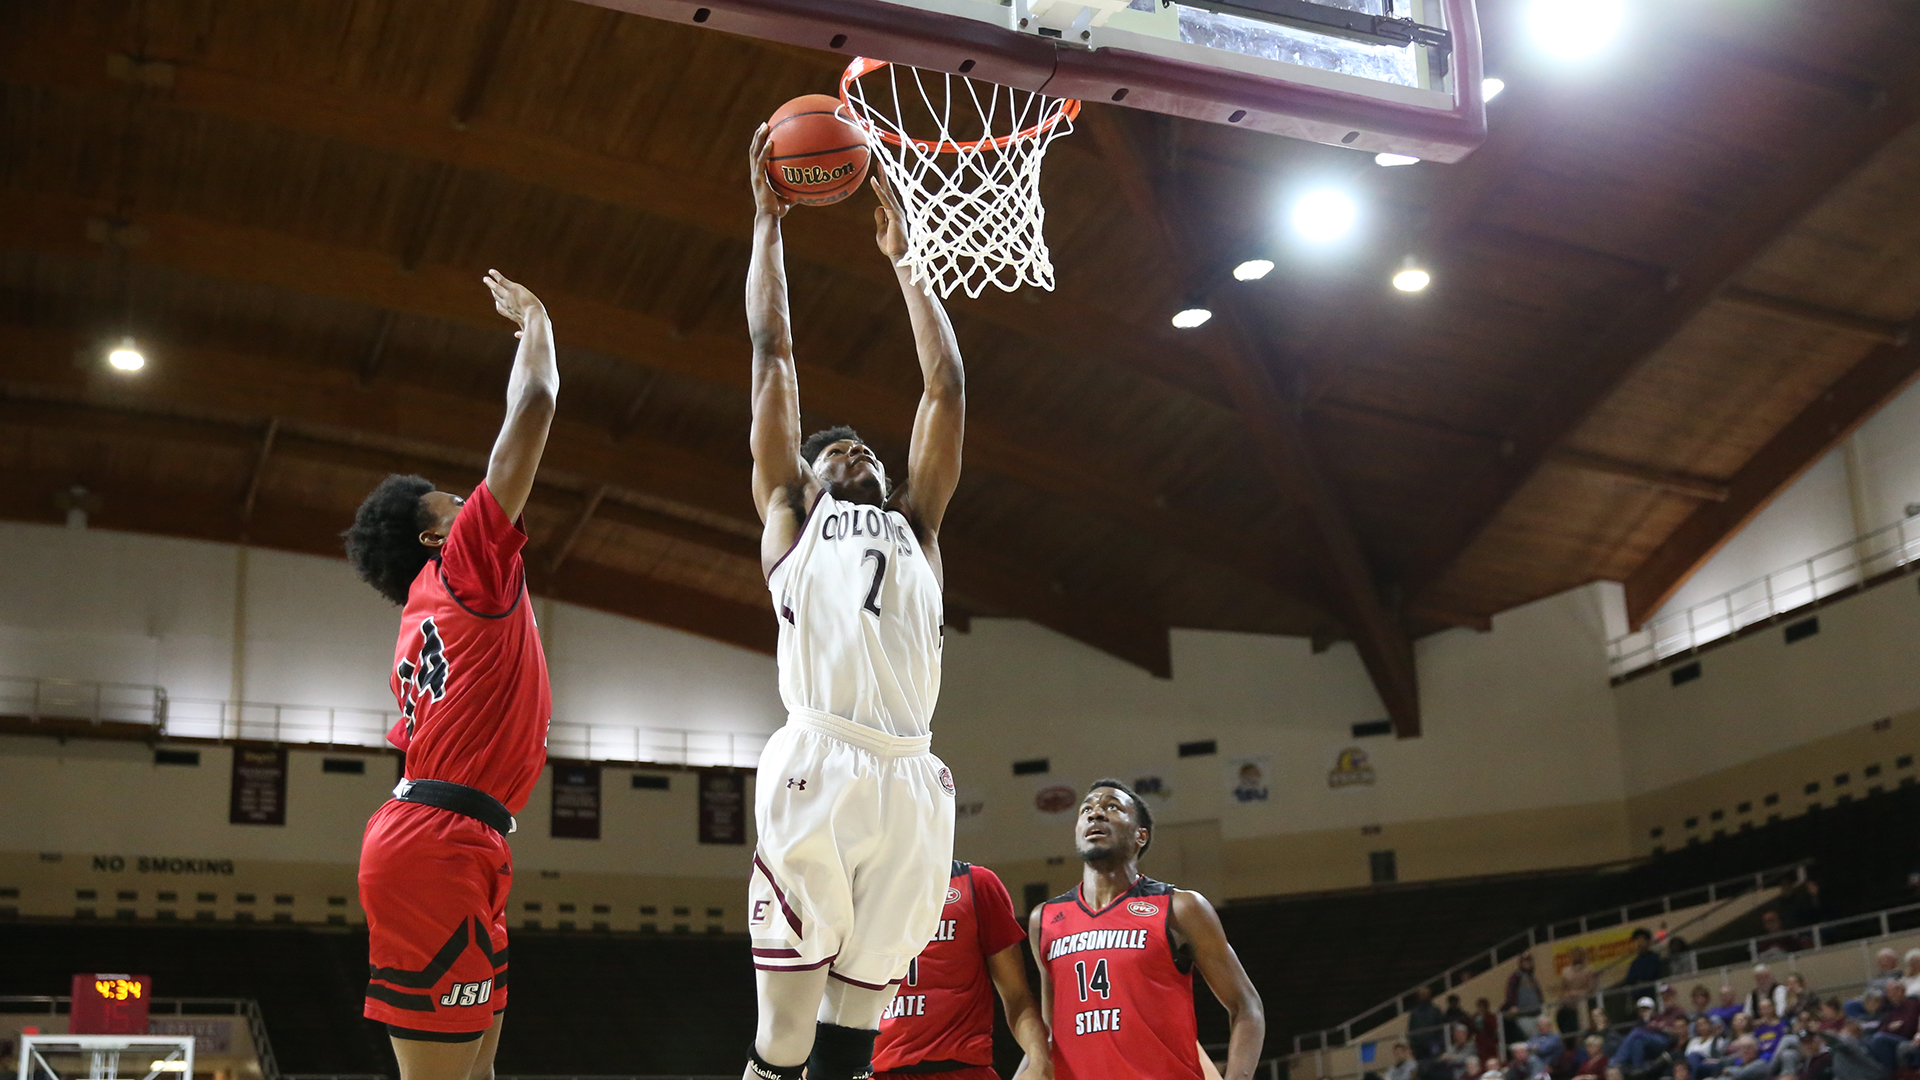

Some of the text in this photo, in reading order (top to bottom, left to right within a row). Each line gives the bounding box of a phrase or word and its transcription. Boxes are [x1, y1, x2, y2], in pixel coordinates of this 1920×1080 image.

[782, 162, 855, 185] Wilson
[860, 548, 886, 619] 2
[93, 856, 234, 876] NO SMOKING
[753, 900, 770, 921] E
[1047, 929, 1148, 961] JACKSONVILLE
[95, 979, 142, 1001] 4:34
[441, 978, 493, 1007] JSU
[1075, 958, 1111, 1002] 14
[1075, 1008, 1121, 1036] STATE
